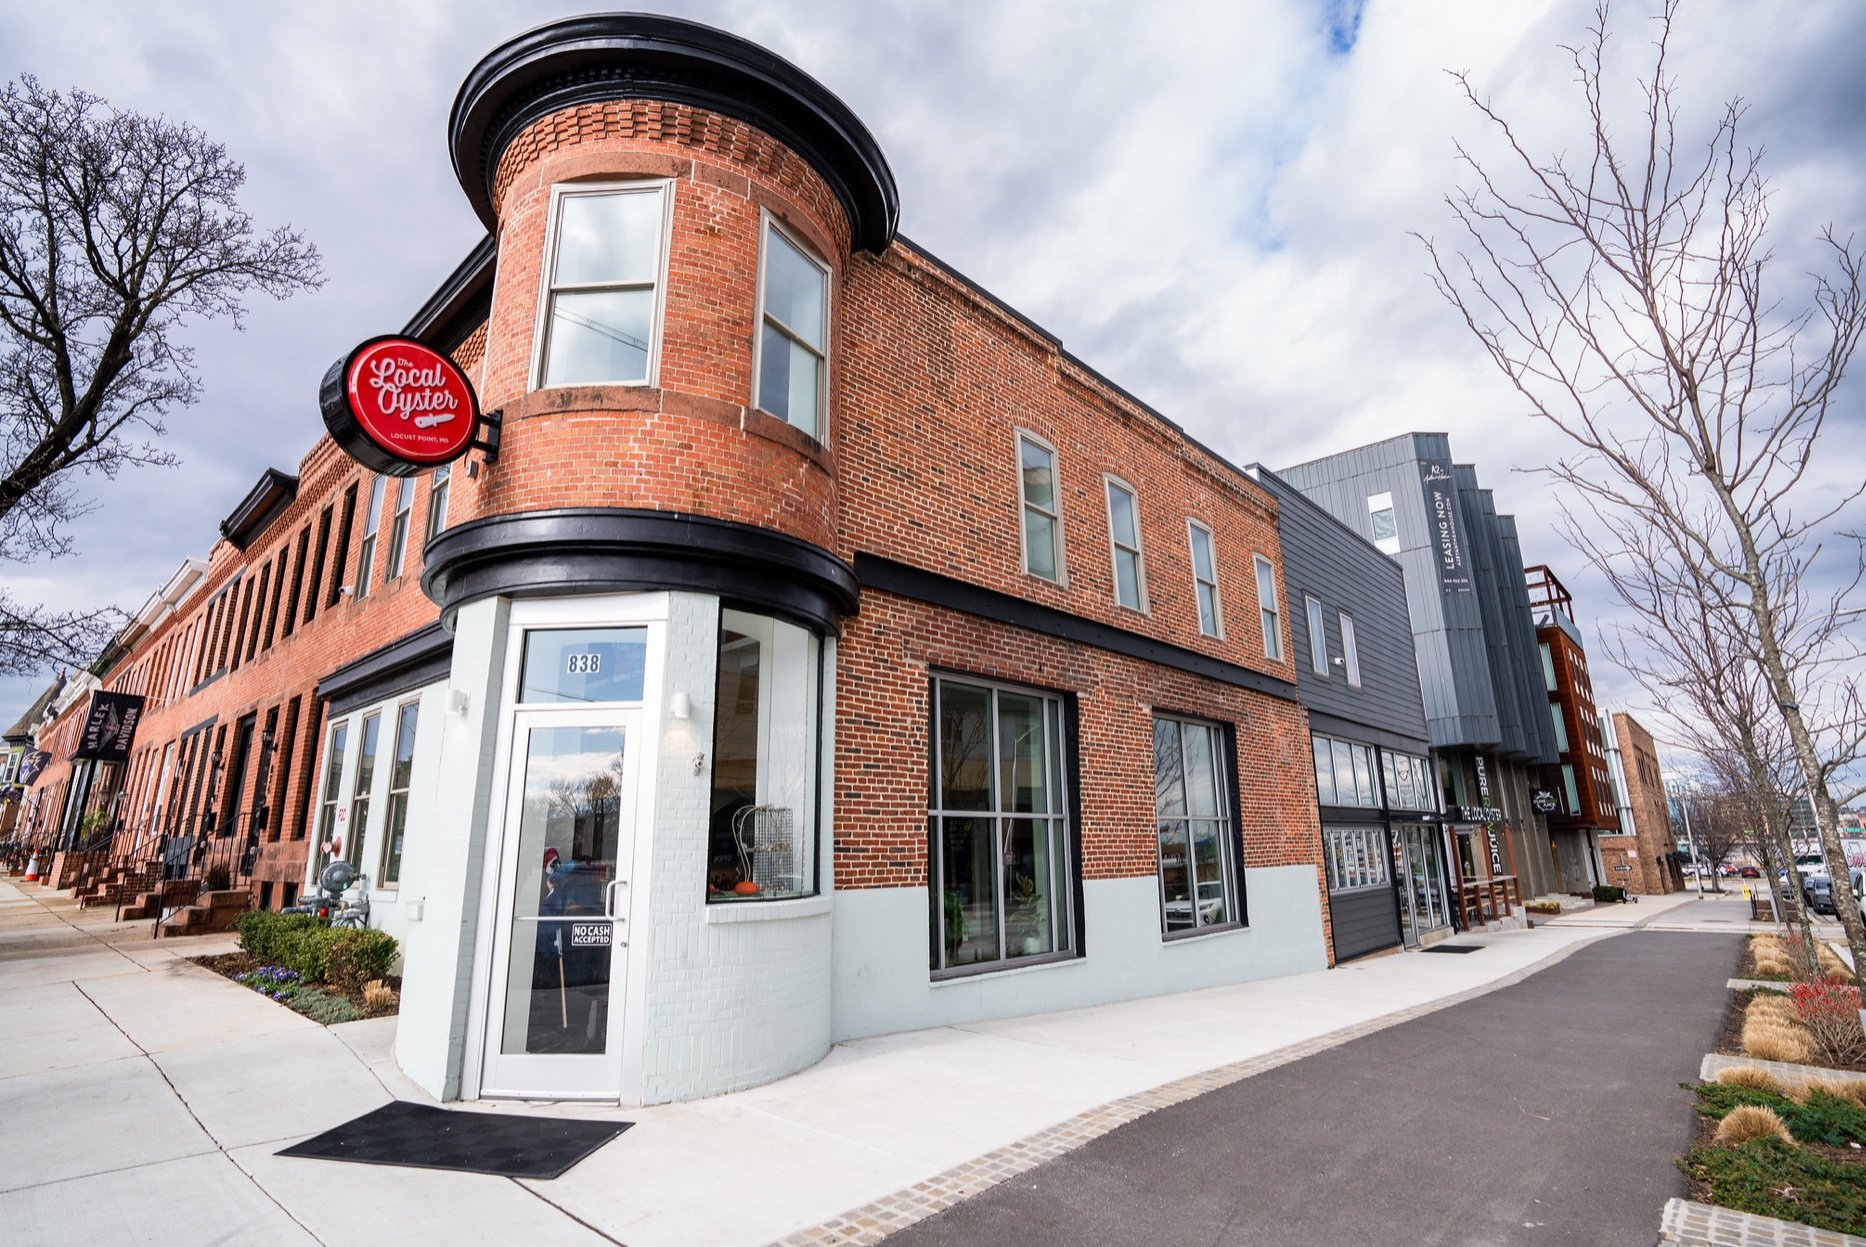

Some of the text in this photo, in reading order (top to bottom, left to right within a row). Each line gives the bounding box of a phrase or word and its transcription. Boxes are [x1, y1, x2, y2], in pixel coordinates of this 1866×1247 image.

[369, 357, 446, 388] Local
[397, 357, 413, 368] The
[377, 382, 458, 420] Oyster
[391, 432, 416, 441] LOCUST
[1433, 491, 1448, 519] NOW
[1438, 521, 1455, 570] LEASING
[568, 654, 599, 673] 838
[87, 703, 110, 749] HARLEY
[115, 707, 138, 751] DAVIDSON
[1460, 805, 1501, 821] THE LOCAL OYSTER
[1475, 756, 1489, 796] PURE
[1488, 830, 1502, 874] JUICE
[573, 936, 610, 944] ACCEPTED
[574, 926, 610, 936] NO CASH
